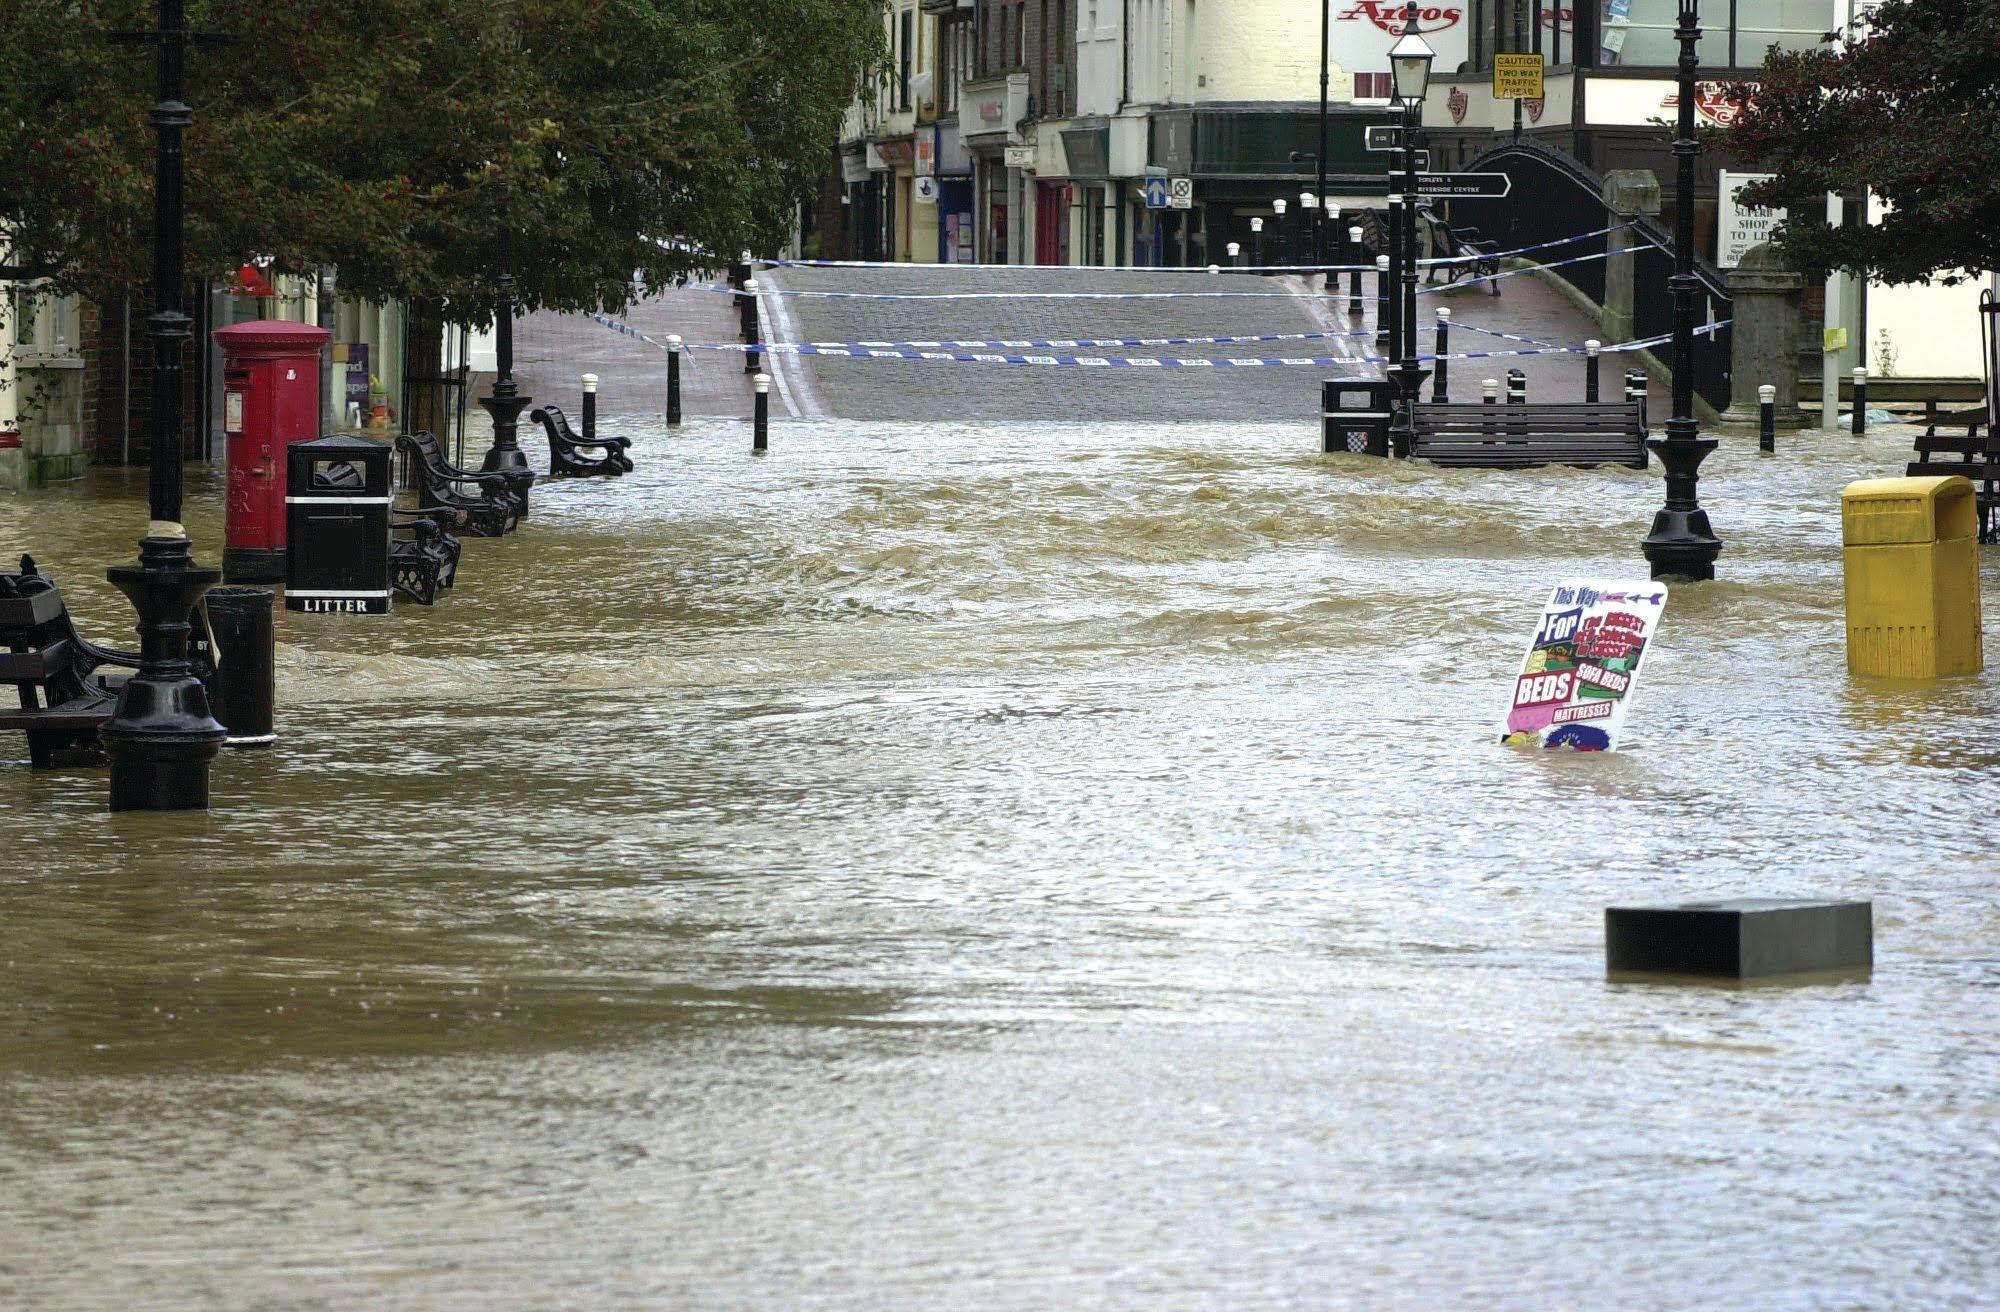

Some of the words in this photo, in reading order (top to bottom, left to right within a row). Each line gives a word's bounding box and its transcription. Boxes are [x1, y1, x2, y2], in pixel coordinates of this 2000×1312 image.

[1497, 57, 1541, 65] CAUTION
[1497, 69, 1517, 77] TWO
[1519, 69, 1540, 77] WAY
[1500, 78, 1538, 86] TRAFFIC
[1734, 208, 1773, 218] SUPERB
[1738, 220, 1769, 229] SHOP
[1731, 231, 1746, 240] TO
[1753, 231, 1769, 240] LE
[1553, 586, 1576, 605] This
[1575, 586, 1600, 608] Way
[303, 599, 367, 612] LITTER
[1544, 613, 1578, 642] For
[1576, 662, 1603, 684] SOFA
[1599, 670, 1629, 692] BEDS
[1515, 672, 1572, 705] BEDS
[1552, 703, 1611, 723] MATTRESSES
